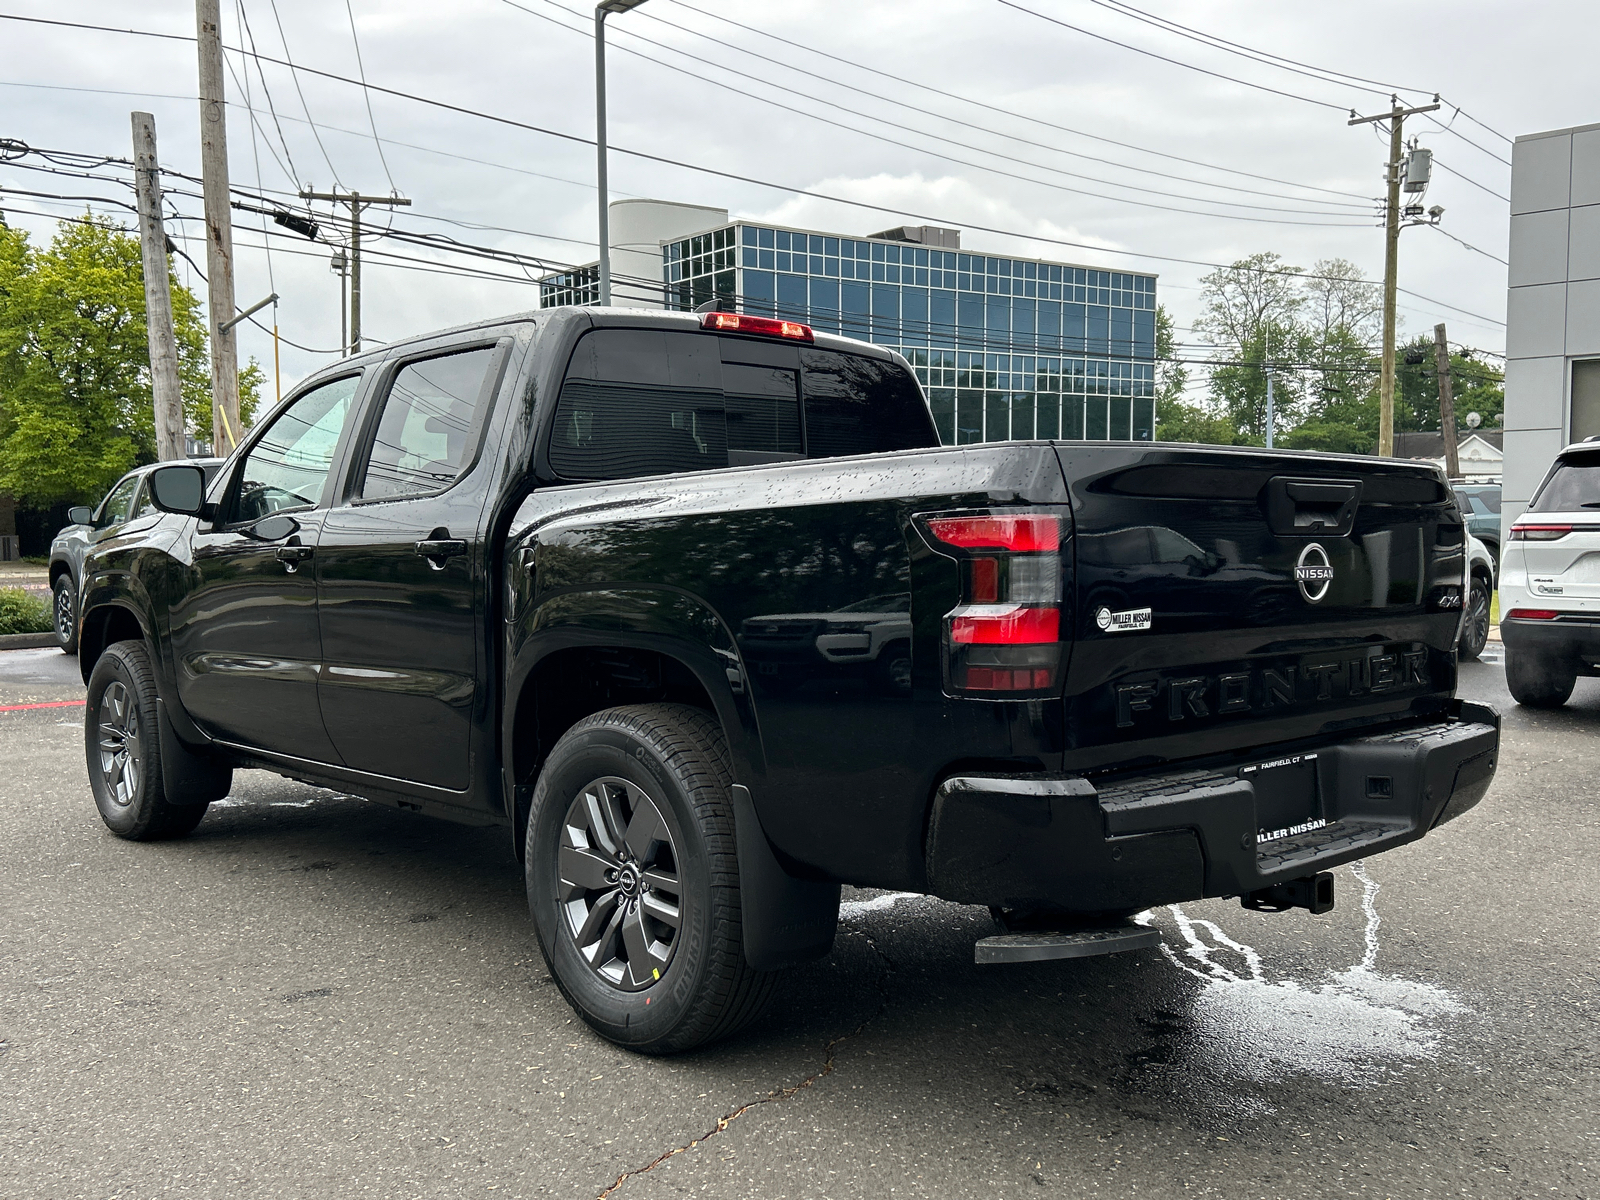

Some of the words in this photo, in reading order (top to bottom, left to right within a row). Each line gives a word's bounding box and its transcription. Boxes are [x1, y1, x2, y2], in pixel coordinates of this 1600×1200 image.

[1296, 569, 1334, 579] NISSAN
[1112, 614, 1131, 624] MILLER
[1133, 612, 1151, 622] NISSAN
[1115, 650, 1428, 728] FRONTIER
[1261, 759, 1291, 769] FAIRFIELD,
[1256, 829, 1288, 843] ILLER
[1289, 818, 1326, 835] NISSAN
[675, 907, 702, 1001] MICHELIN
